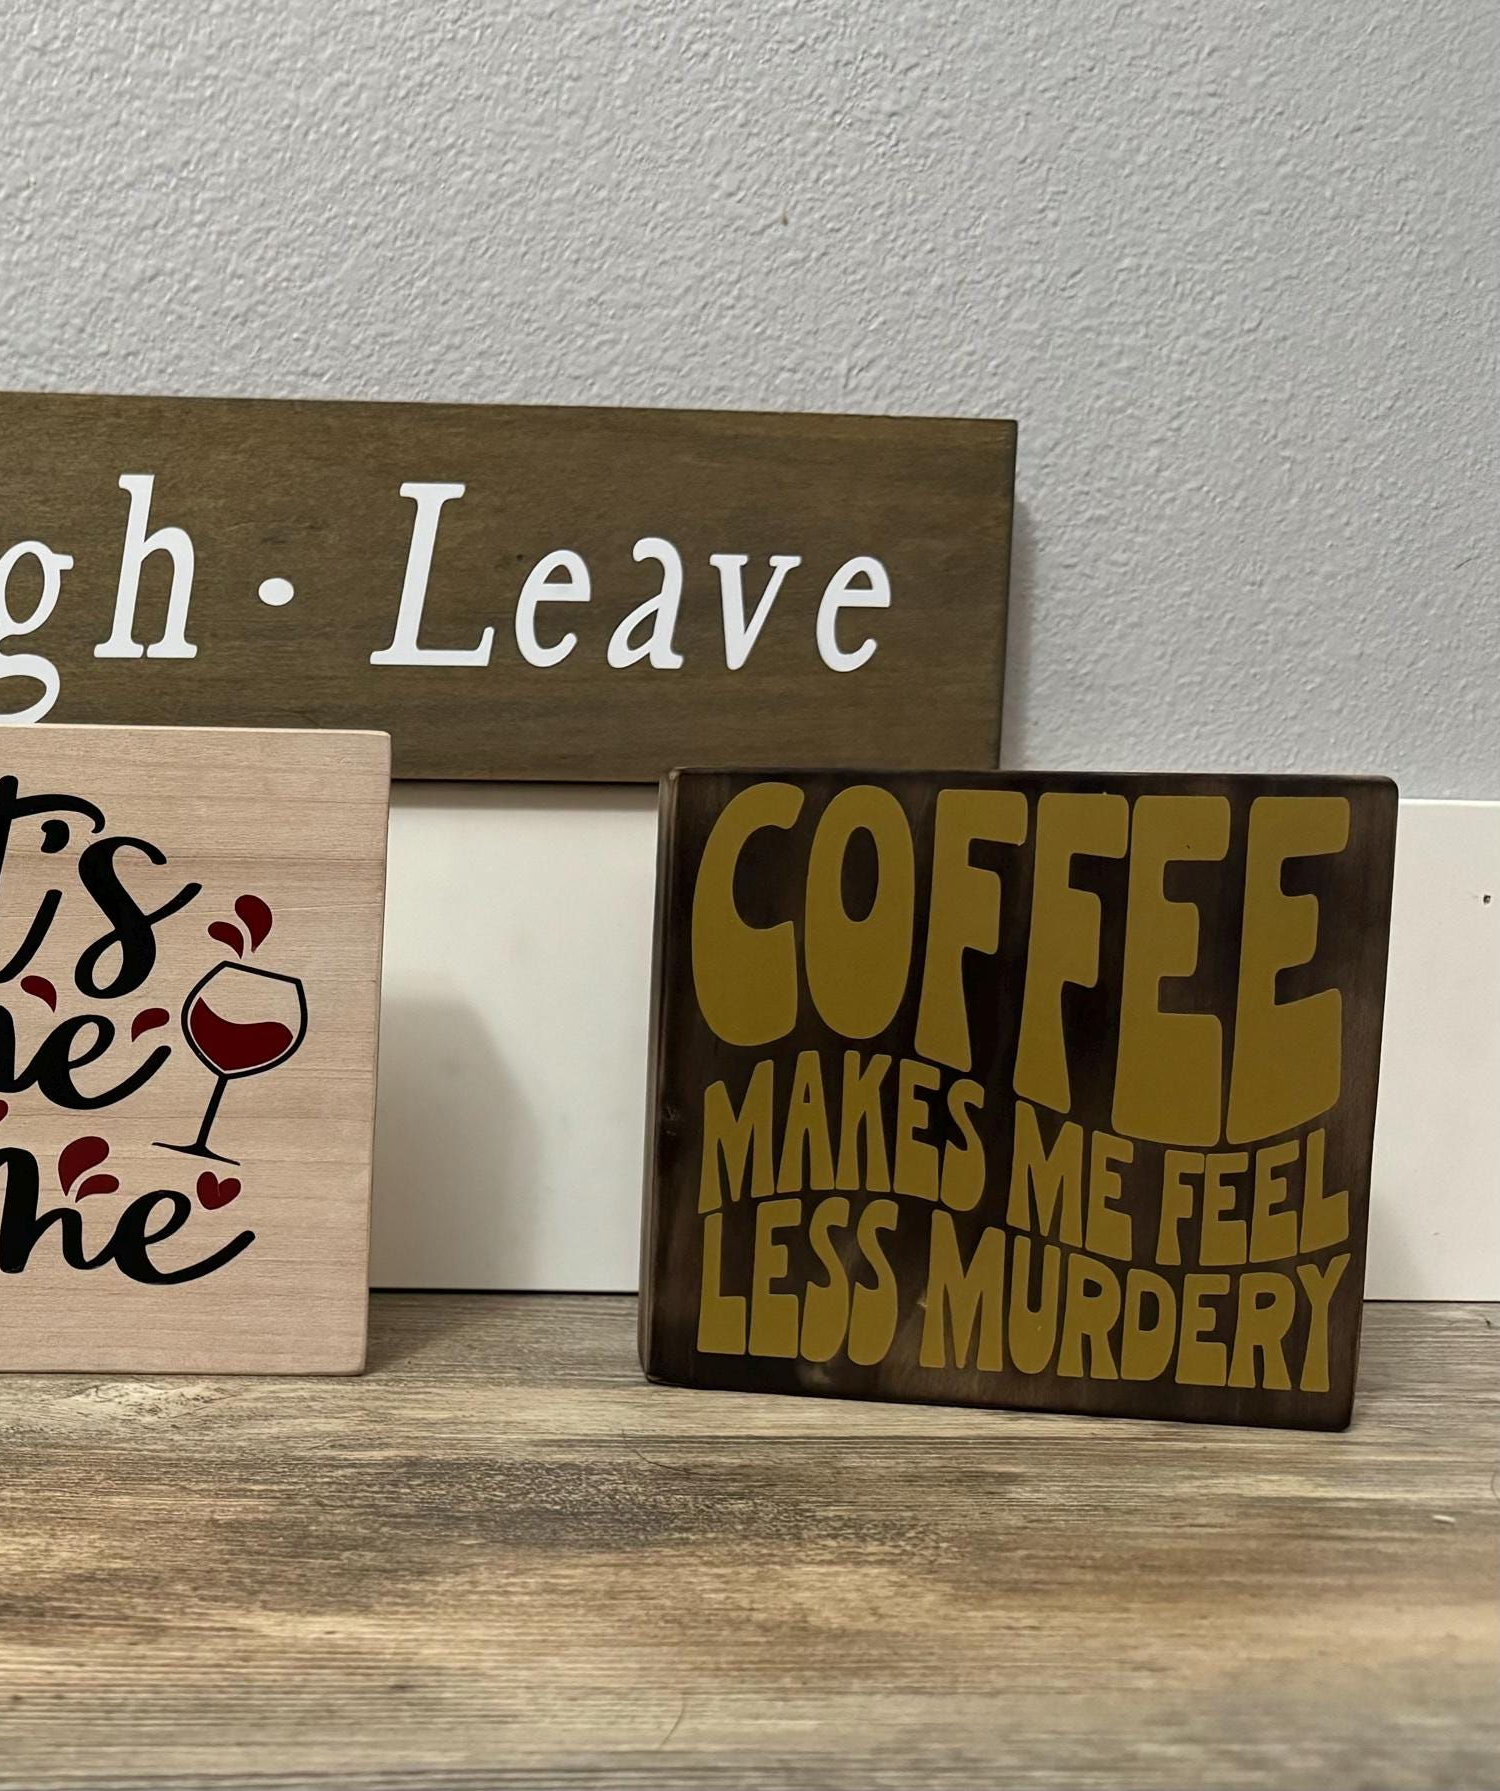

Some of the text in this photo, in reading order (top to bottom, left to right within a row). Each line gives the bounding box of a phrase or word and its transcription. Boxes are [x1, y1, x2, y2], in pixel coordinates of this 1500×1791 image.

[369, 482, 892, 672] Leave
[691, 781, 1350, 1147] COFFEE
[699, 1050, 1350, 1266] MAKES ME FEEL
[697, 1197, 1351, 1393] LESS MURDERY
